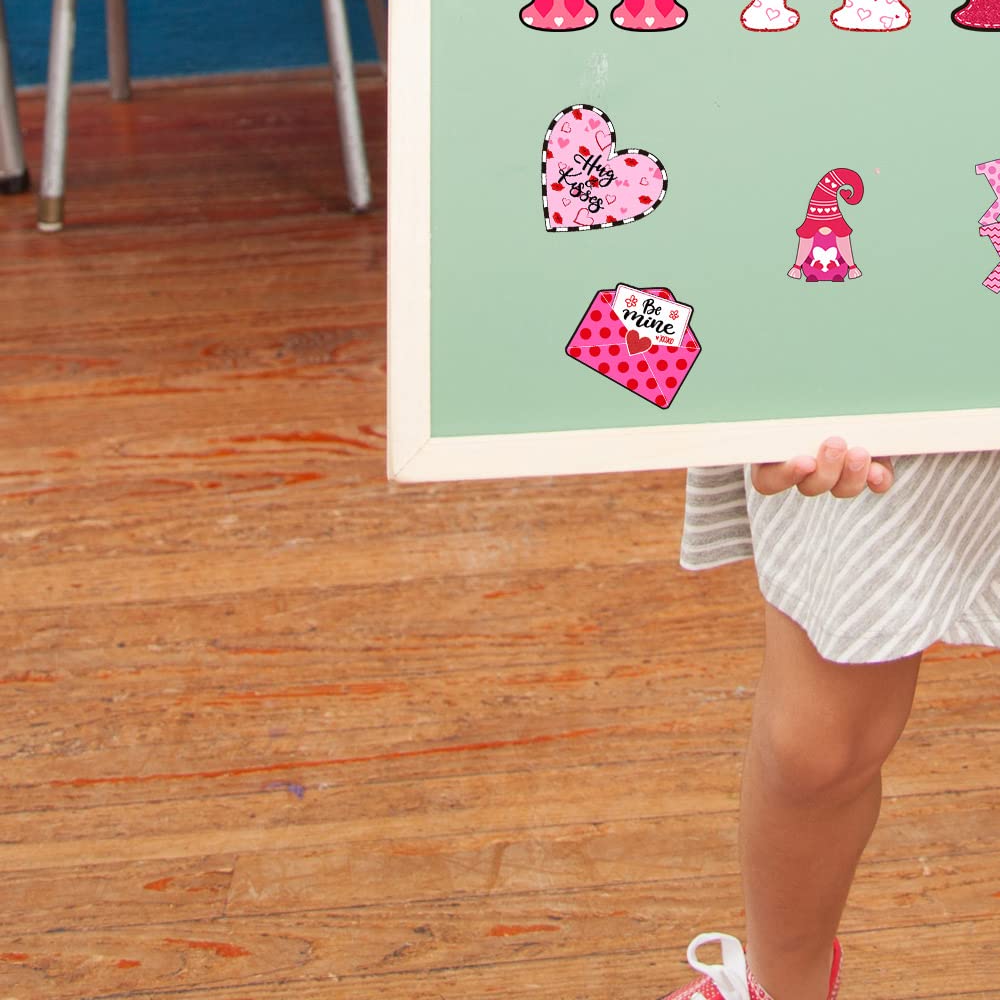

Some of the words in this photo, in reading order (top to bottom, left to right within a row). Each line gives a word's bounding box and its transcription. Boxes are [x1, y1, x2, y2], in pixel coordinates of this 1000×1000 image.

[573, 153, 618, 187] Hug
[557, 167, 605, 213] Kisses
[622, 308, 676, 335] mine
[642, 298, 662, 316] Be
